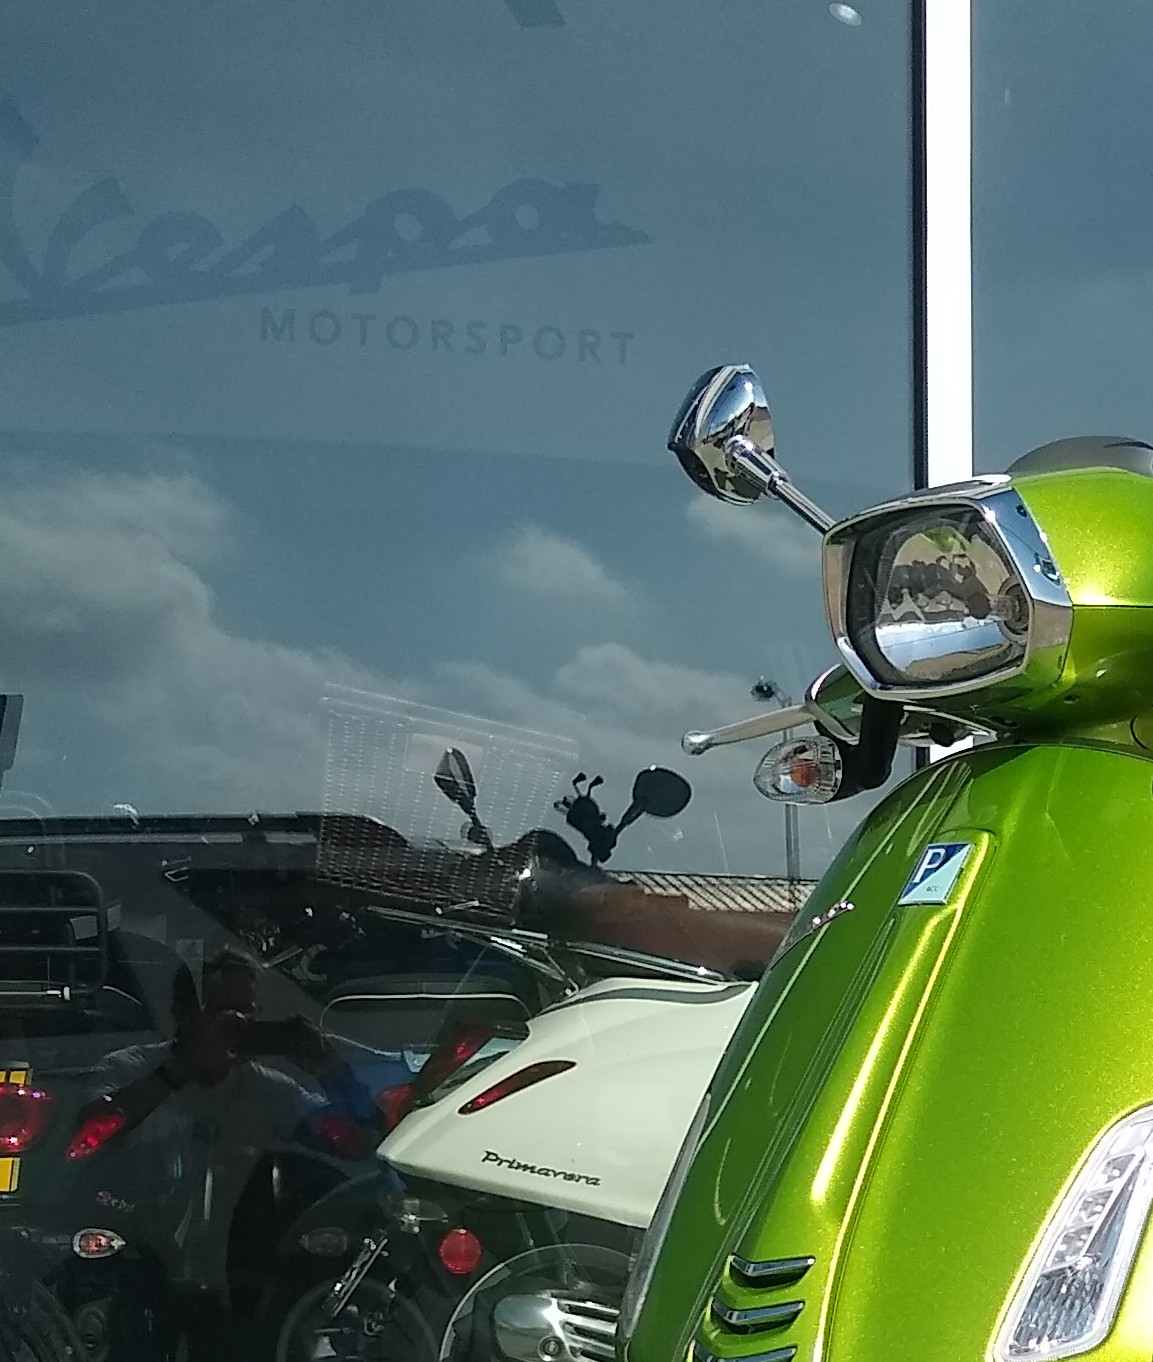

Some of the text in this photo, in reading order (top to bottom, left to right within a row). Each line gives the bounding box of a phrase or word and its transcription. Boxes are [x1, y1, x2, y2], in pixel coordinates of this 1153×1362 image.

[259, 307, 636, 367] MOTORSPORT
[912, 848, 946, 884] P
[481, 1150, 602, 1186] Primavera
